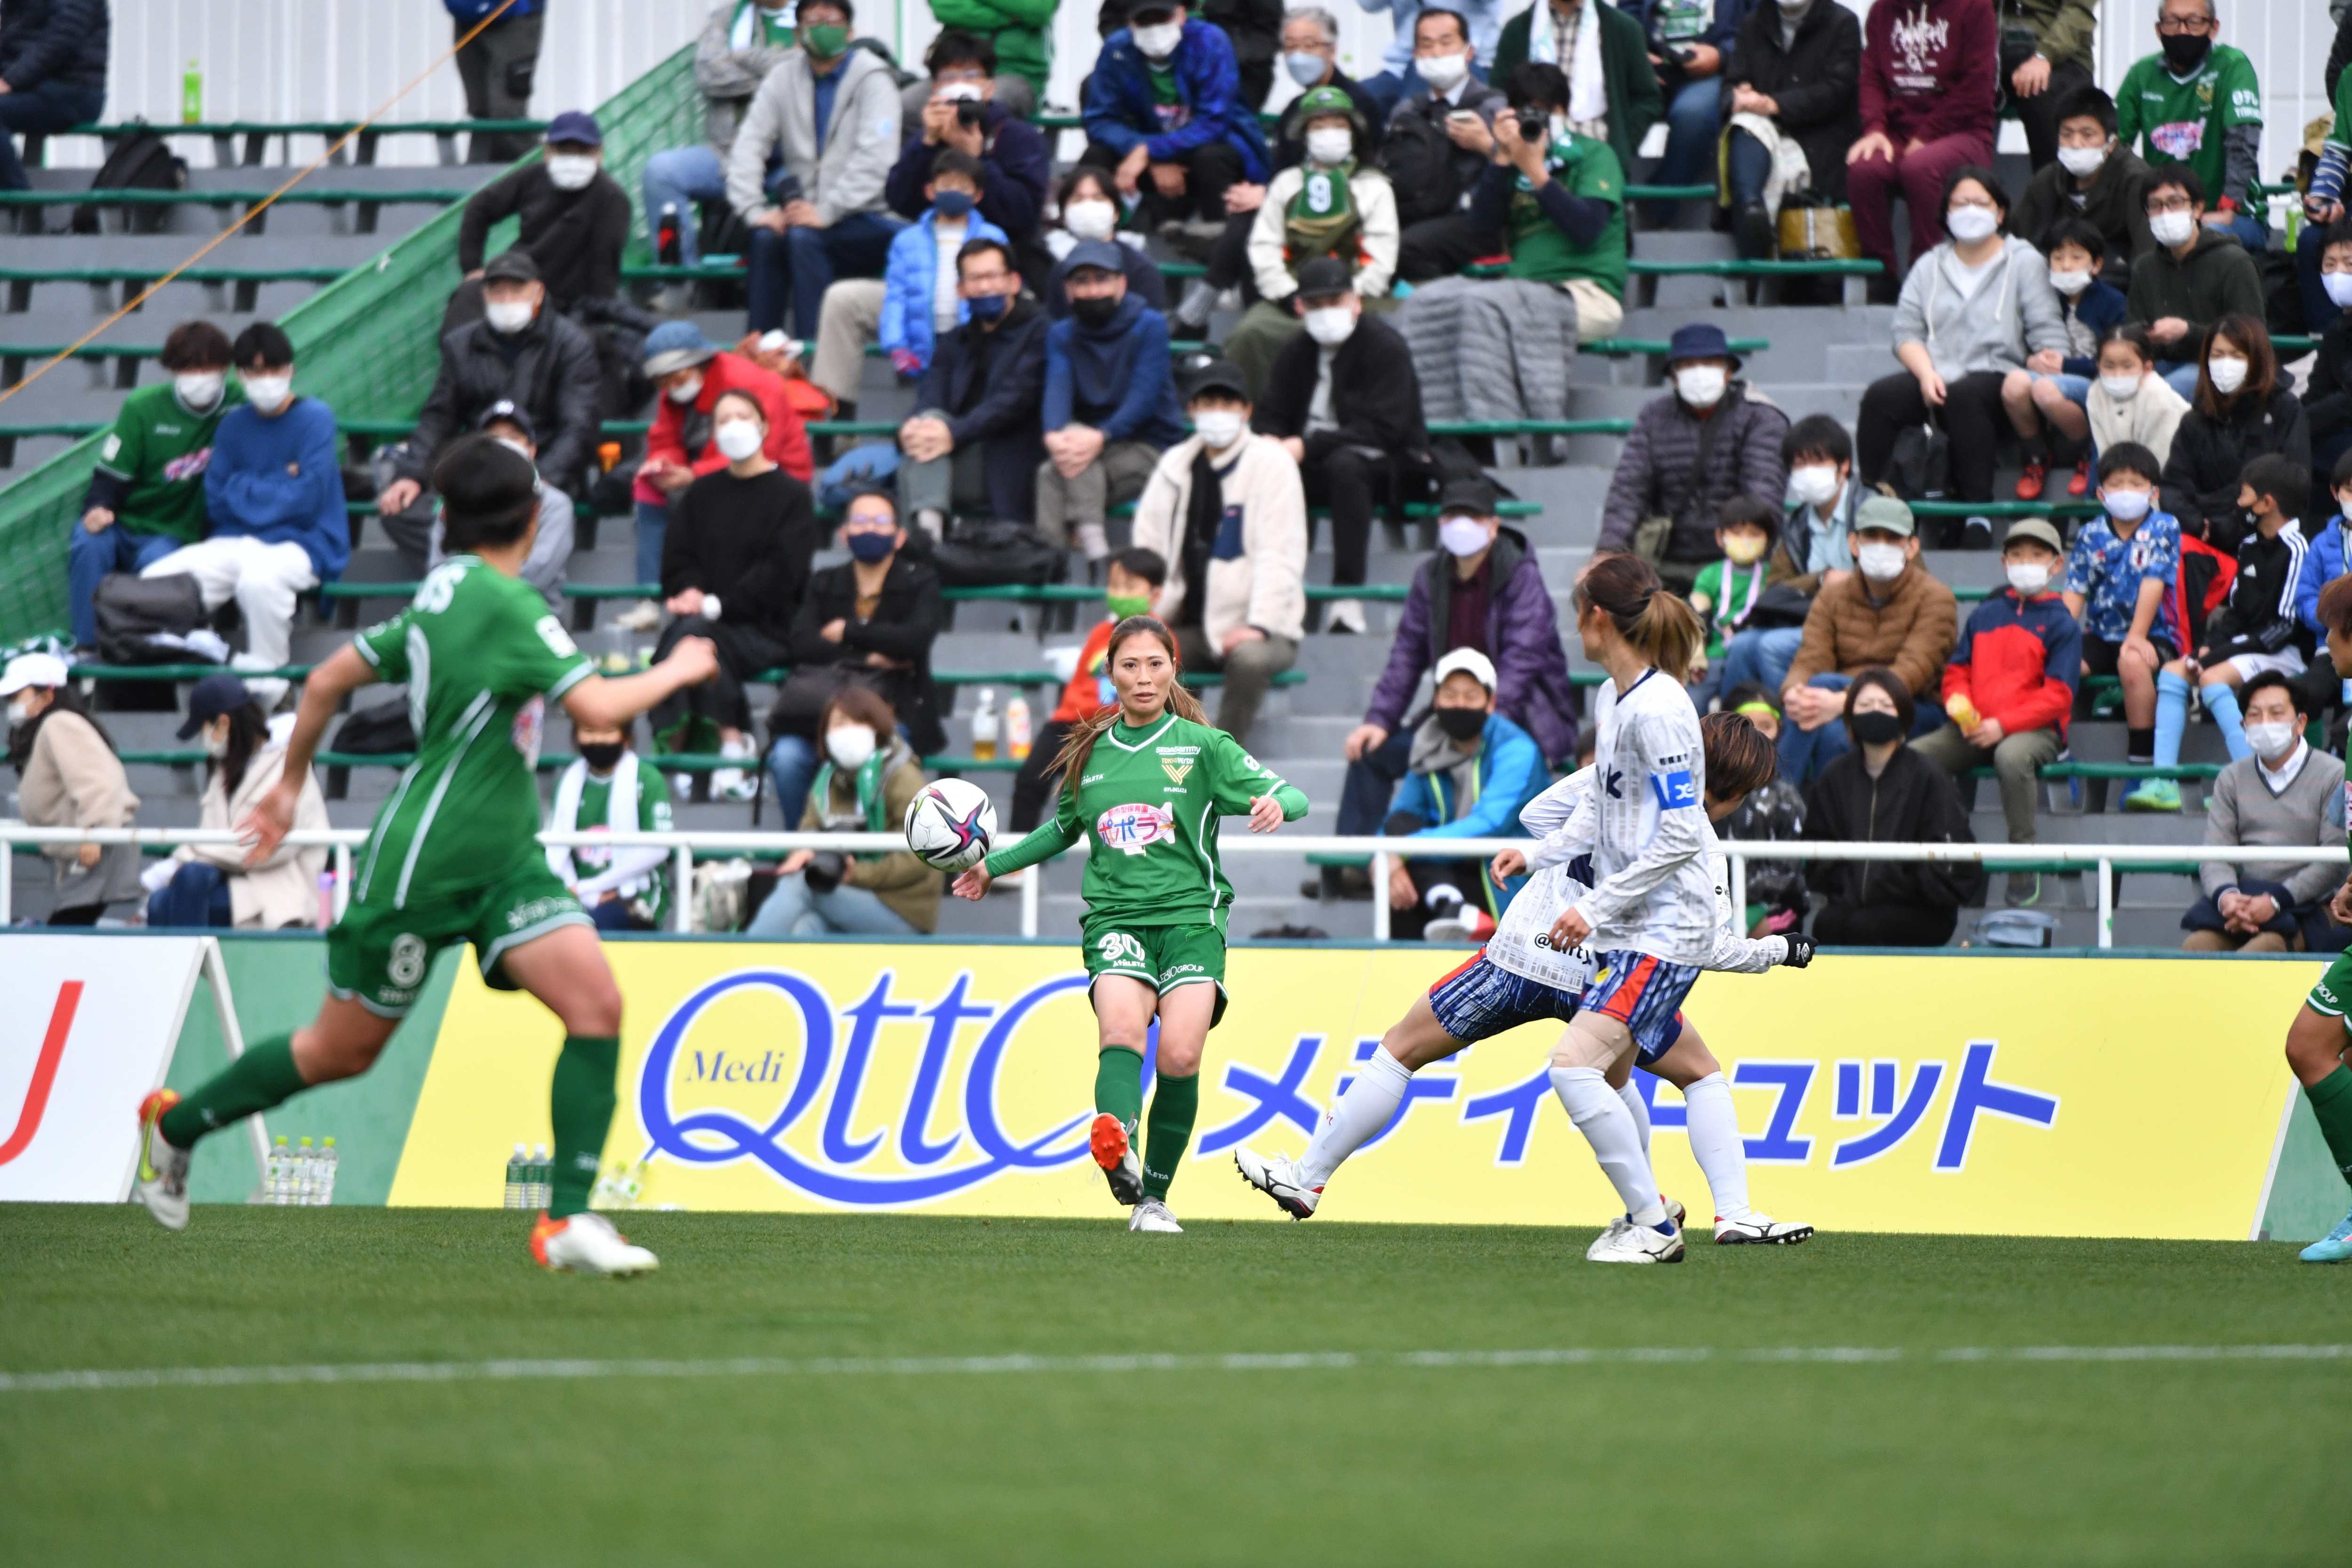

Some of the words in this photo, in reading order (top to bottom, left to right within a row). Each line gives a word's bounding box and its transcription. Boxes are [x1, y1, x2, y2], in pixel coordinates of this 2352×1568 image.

[1107, 804, 1149, 818] 都市型保育園
[387, 932, 426, 989] 8
[1098, 930, 1145, 961] 30
[1113, 959, 1145, 968] ATHLETA
[686, 1051, 785, 1082] Medi
[1197, 1038, 2057, 1168] メディュット
